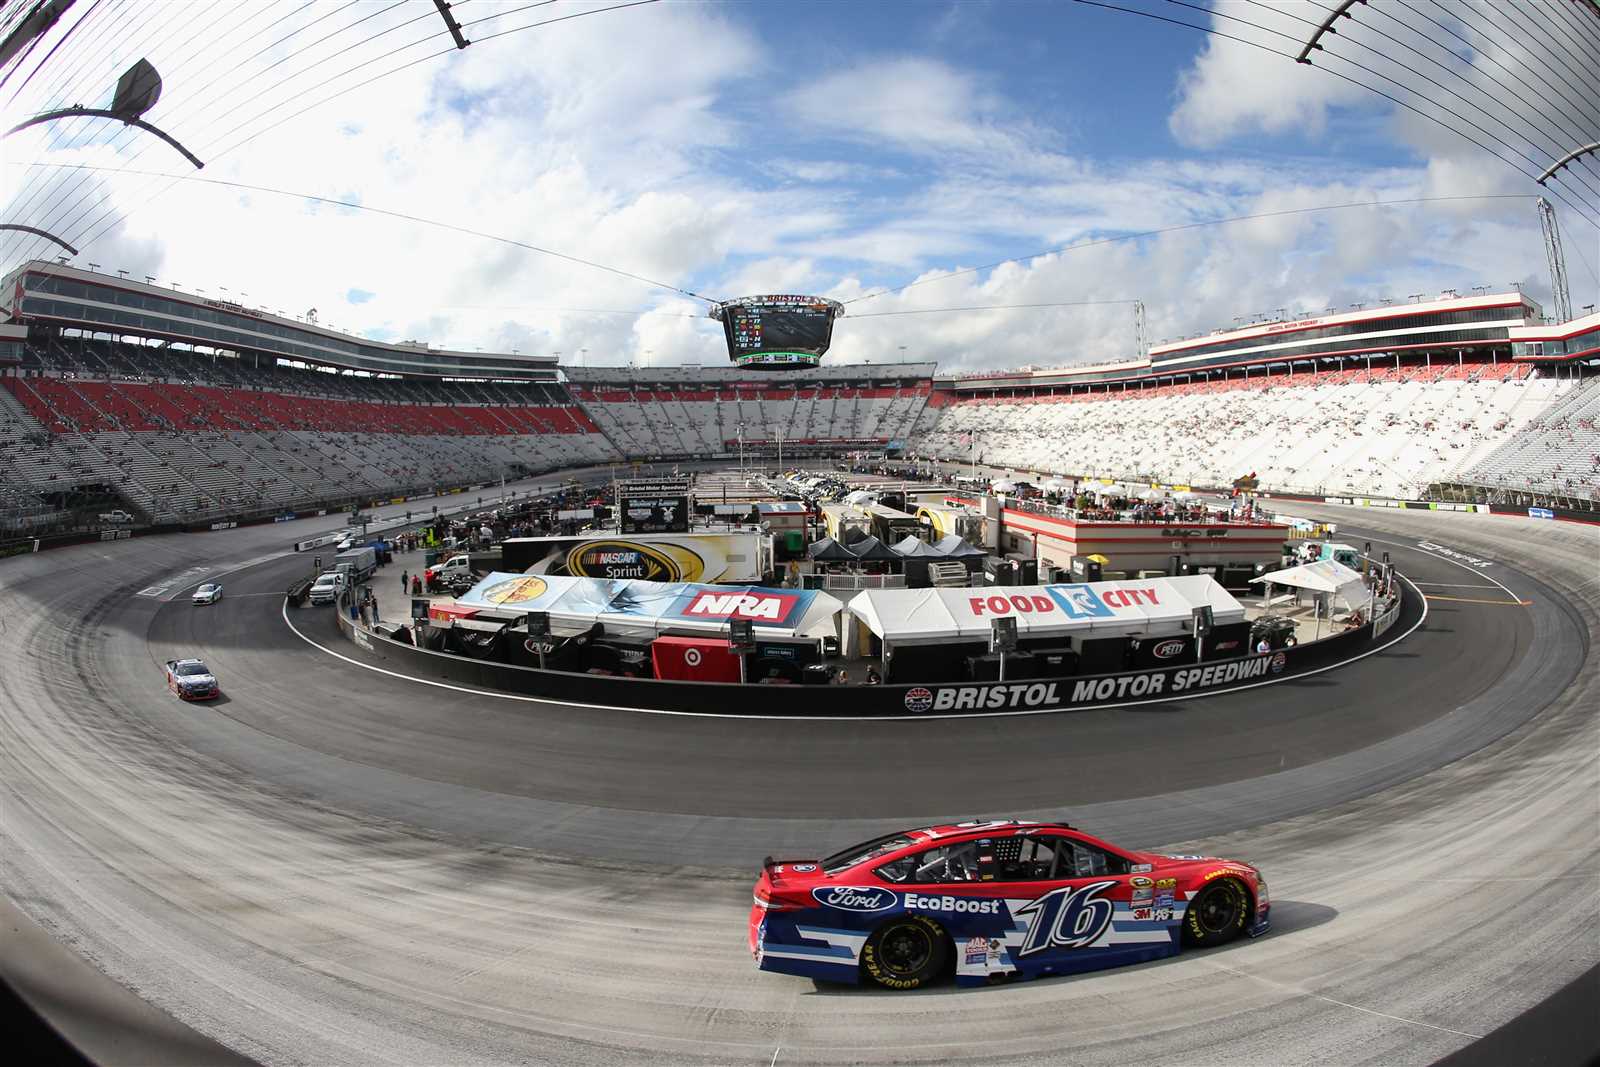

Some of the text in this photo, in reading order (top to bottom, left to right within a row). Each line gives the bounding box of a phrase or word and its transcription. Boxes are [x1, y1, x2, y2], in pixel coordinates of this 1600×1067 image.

[600, 552, 636, 564] NASCAR
[606, 565, 643, 579] Sprint
[690, 594, 781, 619] NRA
[970, 588, 1160, 615] FOOD CITY
[1160, 642, 1185, 654] PETTY
[933, 656, 1274, 711] BRISTOL MOTOR SPEEDWAY
[827, 887, 882, 909] Ford
[904, 893, 1000, 914] EcoBoost
[1014, 880, 1120, 957] 16
[1134, 908, 1151, 920] 3M
